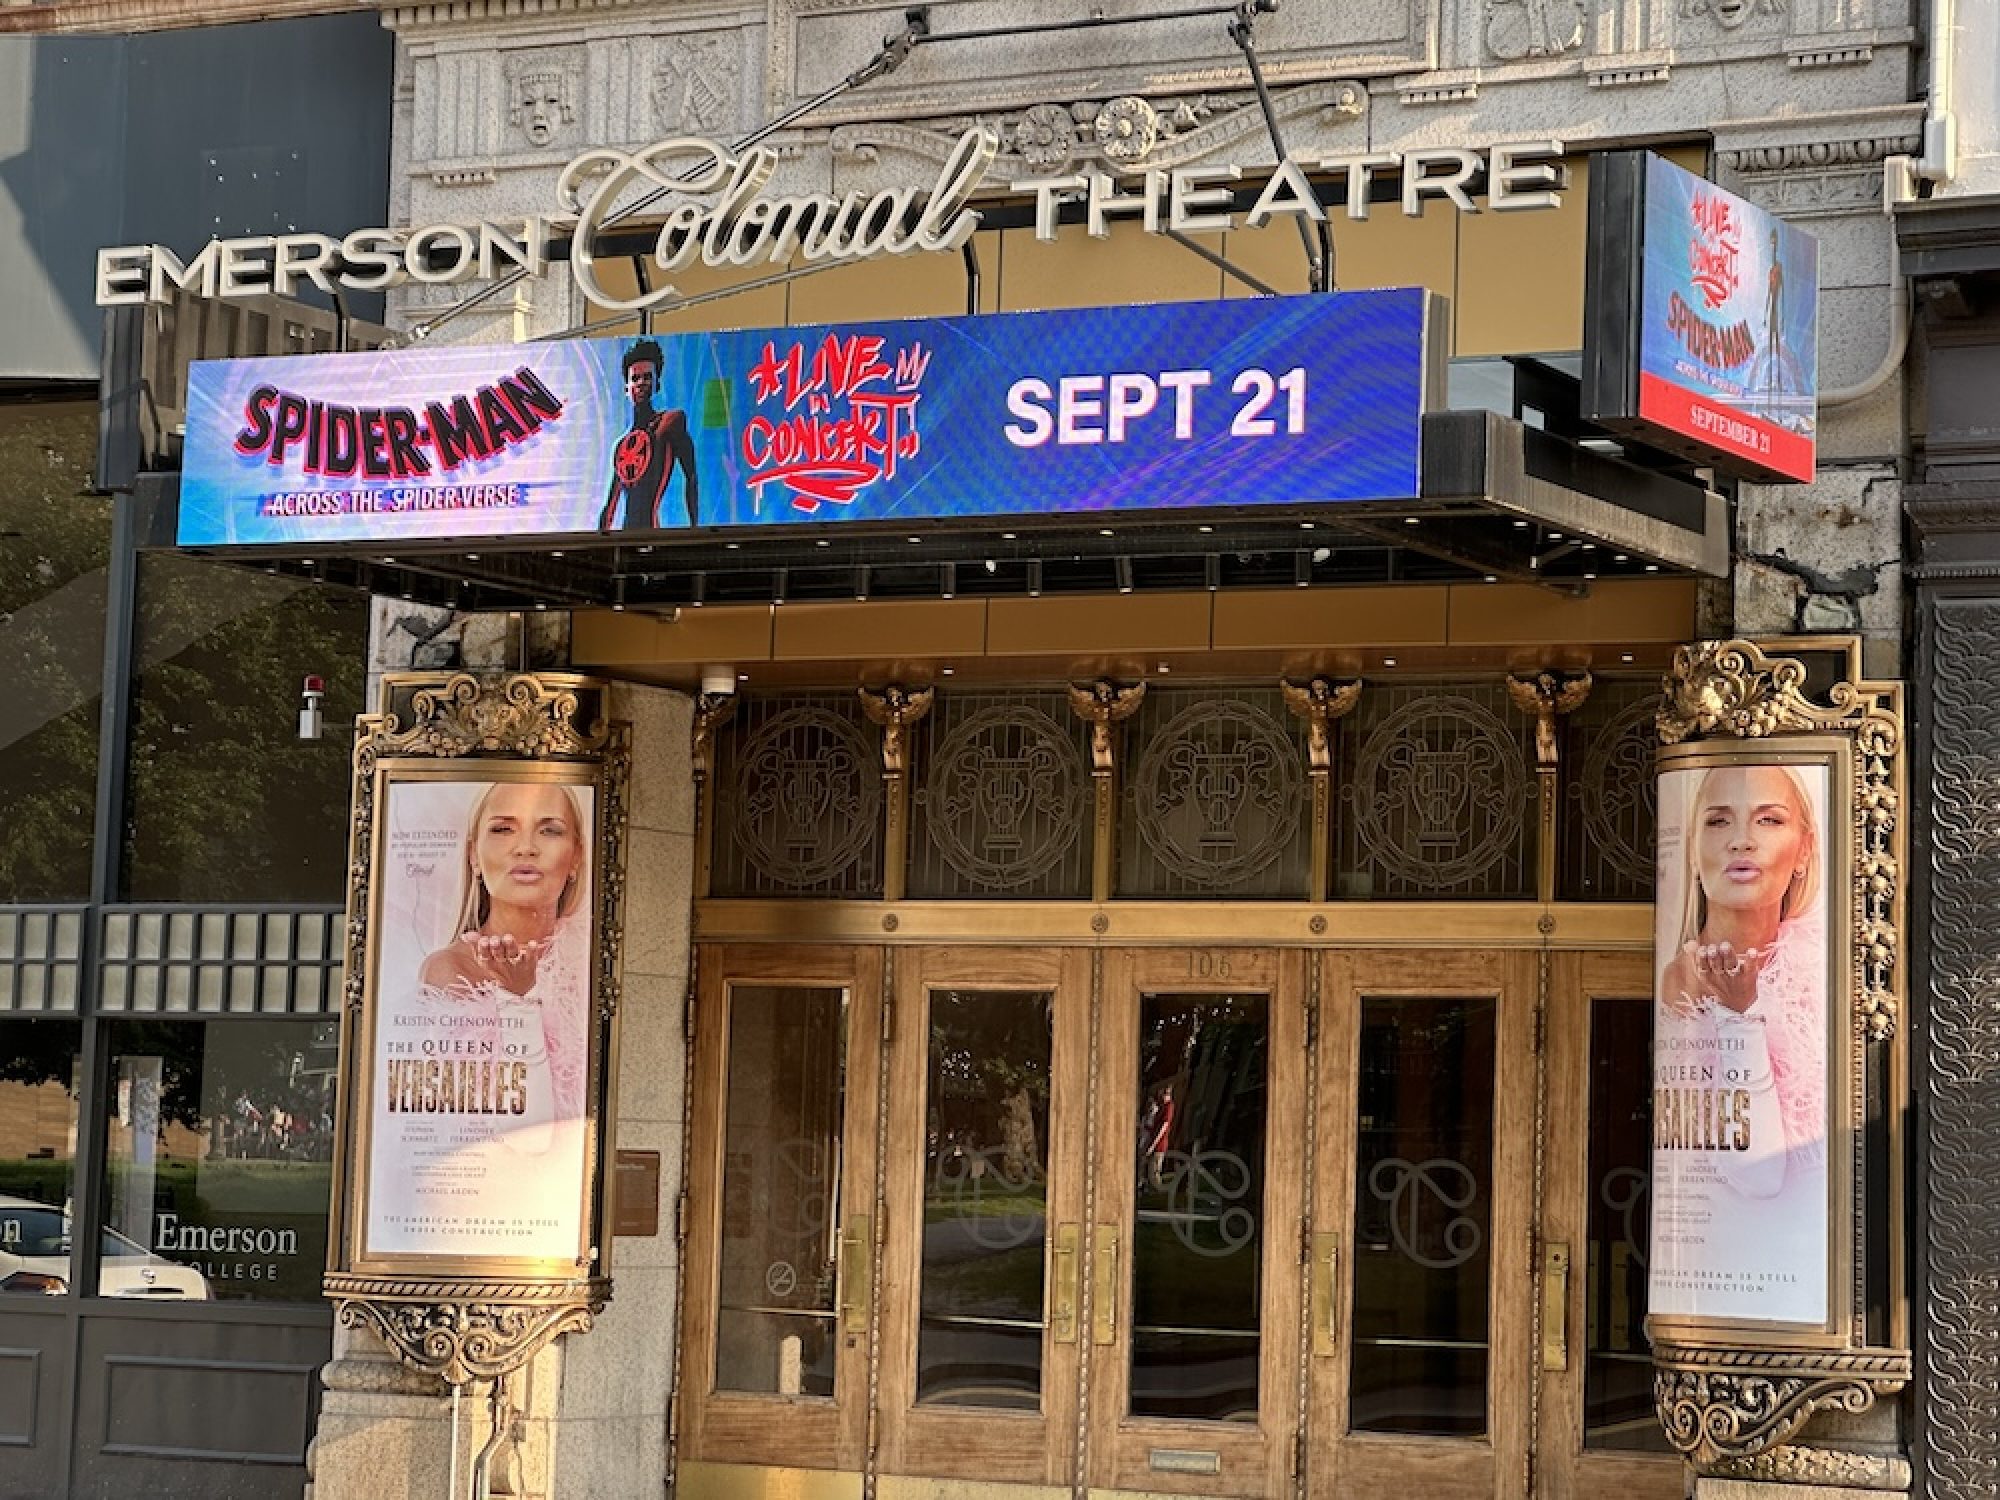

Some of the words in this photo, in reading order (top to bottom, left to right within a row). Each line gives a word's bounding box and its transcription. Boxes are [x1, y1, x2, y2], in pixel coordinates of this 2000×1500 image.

[94, 215, 549, 306] EMERSON
[558, 127, 999, 310] Colonial
[1010, 139, 1565, 243] THEATRE
[235, 366, 565, 481] SPIDER-MAN
[1003, 370, 1211, 449] SEPT
[1230, 367, 1307, 438] 21
[1690, 403, 1758, 448] SEPTEMBER
[268, 491, 341, 517] ACROSS
[351, 489, 384, 513] THE
[393, 1014, 435, 1026] KRISTIN
[440, 1014, 525, 1029] CHENOWETH
[387, 1041, 413, 1053] THE
[422, 1040, 493, 1056] QUEEN
[505, 1044, 528, 1056] OF
[388, 1059, 527, 1115] VERSAILLES
[1727, 1069, 1752, 1082] OF
[155, 1213, 298, 1255] Emerson
